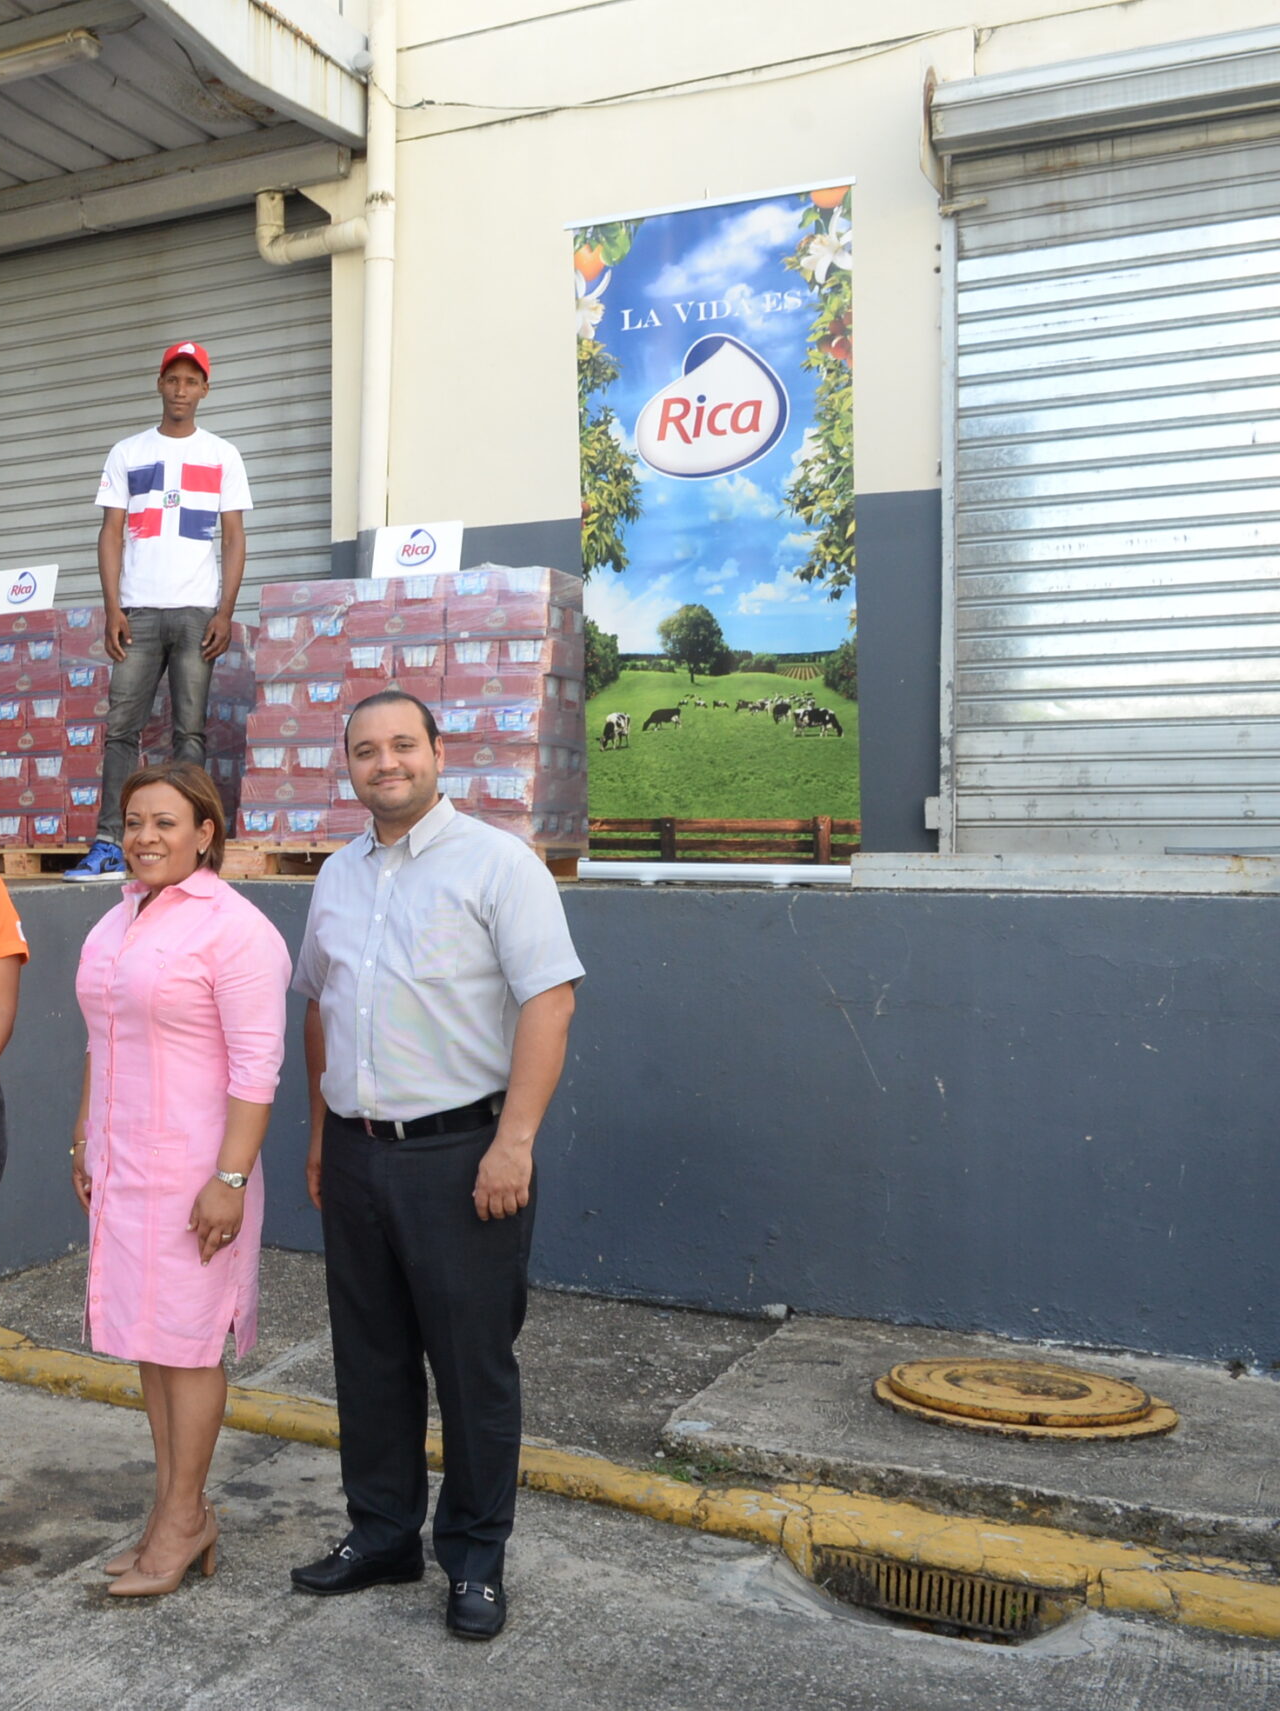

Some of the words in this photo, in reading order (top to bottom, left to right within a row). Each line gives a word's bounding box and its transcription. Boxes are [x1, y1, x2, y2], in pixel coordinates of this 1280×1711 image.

[621, 308, 662, 331] LA
[673, 297, 753, 323] VIDA
[763, 289, 803, 314] ES
[656, 394, 763, 444] Rica
[401, 543, 431, 557] Rica
[10, 584, 32, 596] Rica
